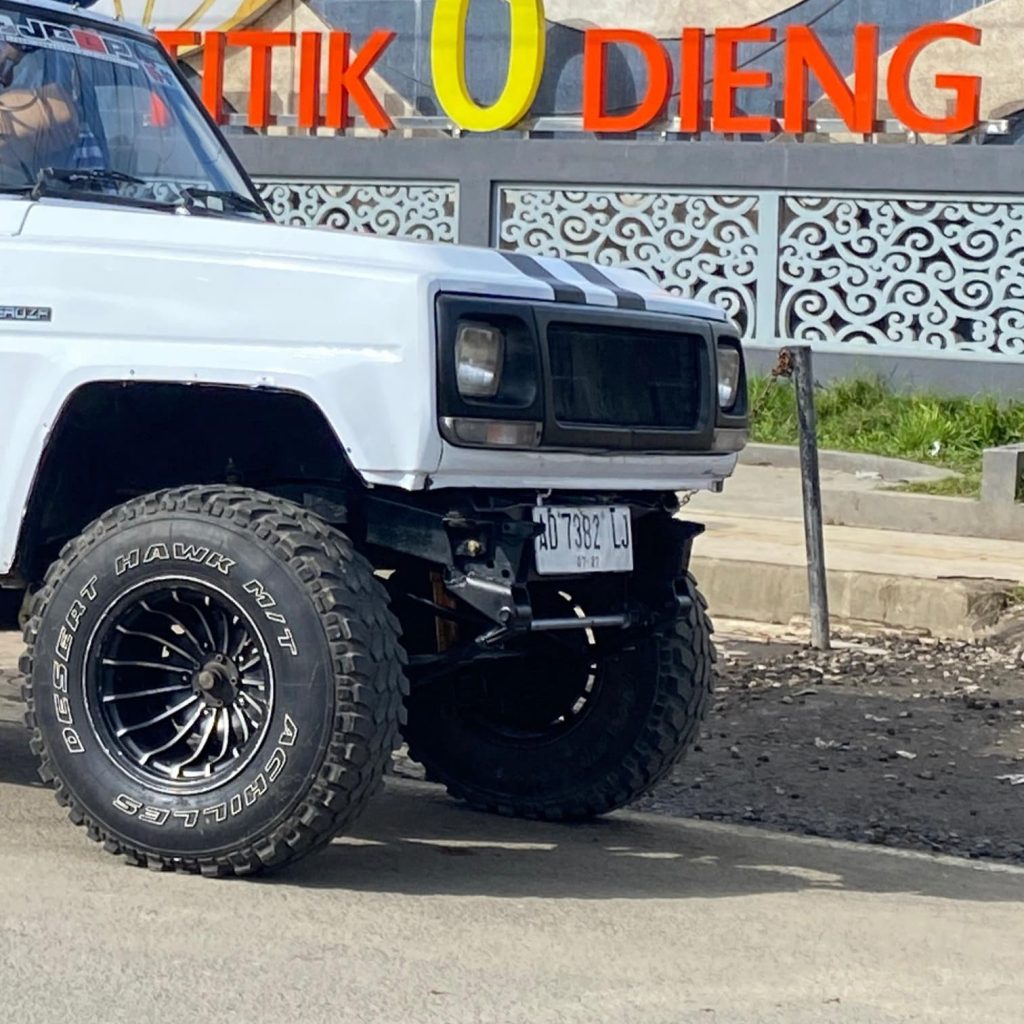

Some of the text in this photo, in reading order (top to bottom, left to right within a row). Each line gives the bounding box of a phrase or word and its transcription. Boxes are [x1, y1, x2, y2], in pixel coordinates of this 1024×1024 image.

[583, 22, 982, 135] DIENG
[560, 513, 601, 551] 7382
[50, 576, 99, 754] DESERT
[114, 542, 237, 576] HAWK
[112, 714, 299, 828] ACHILLES
